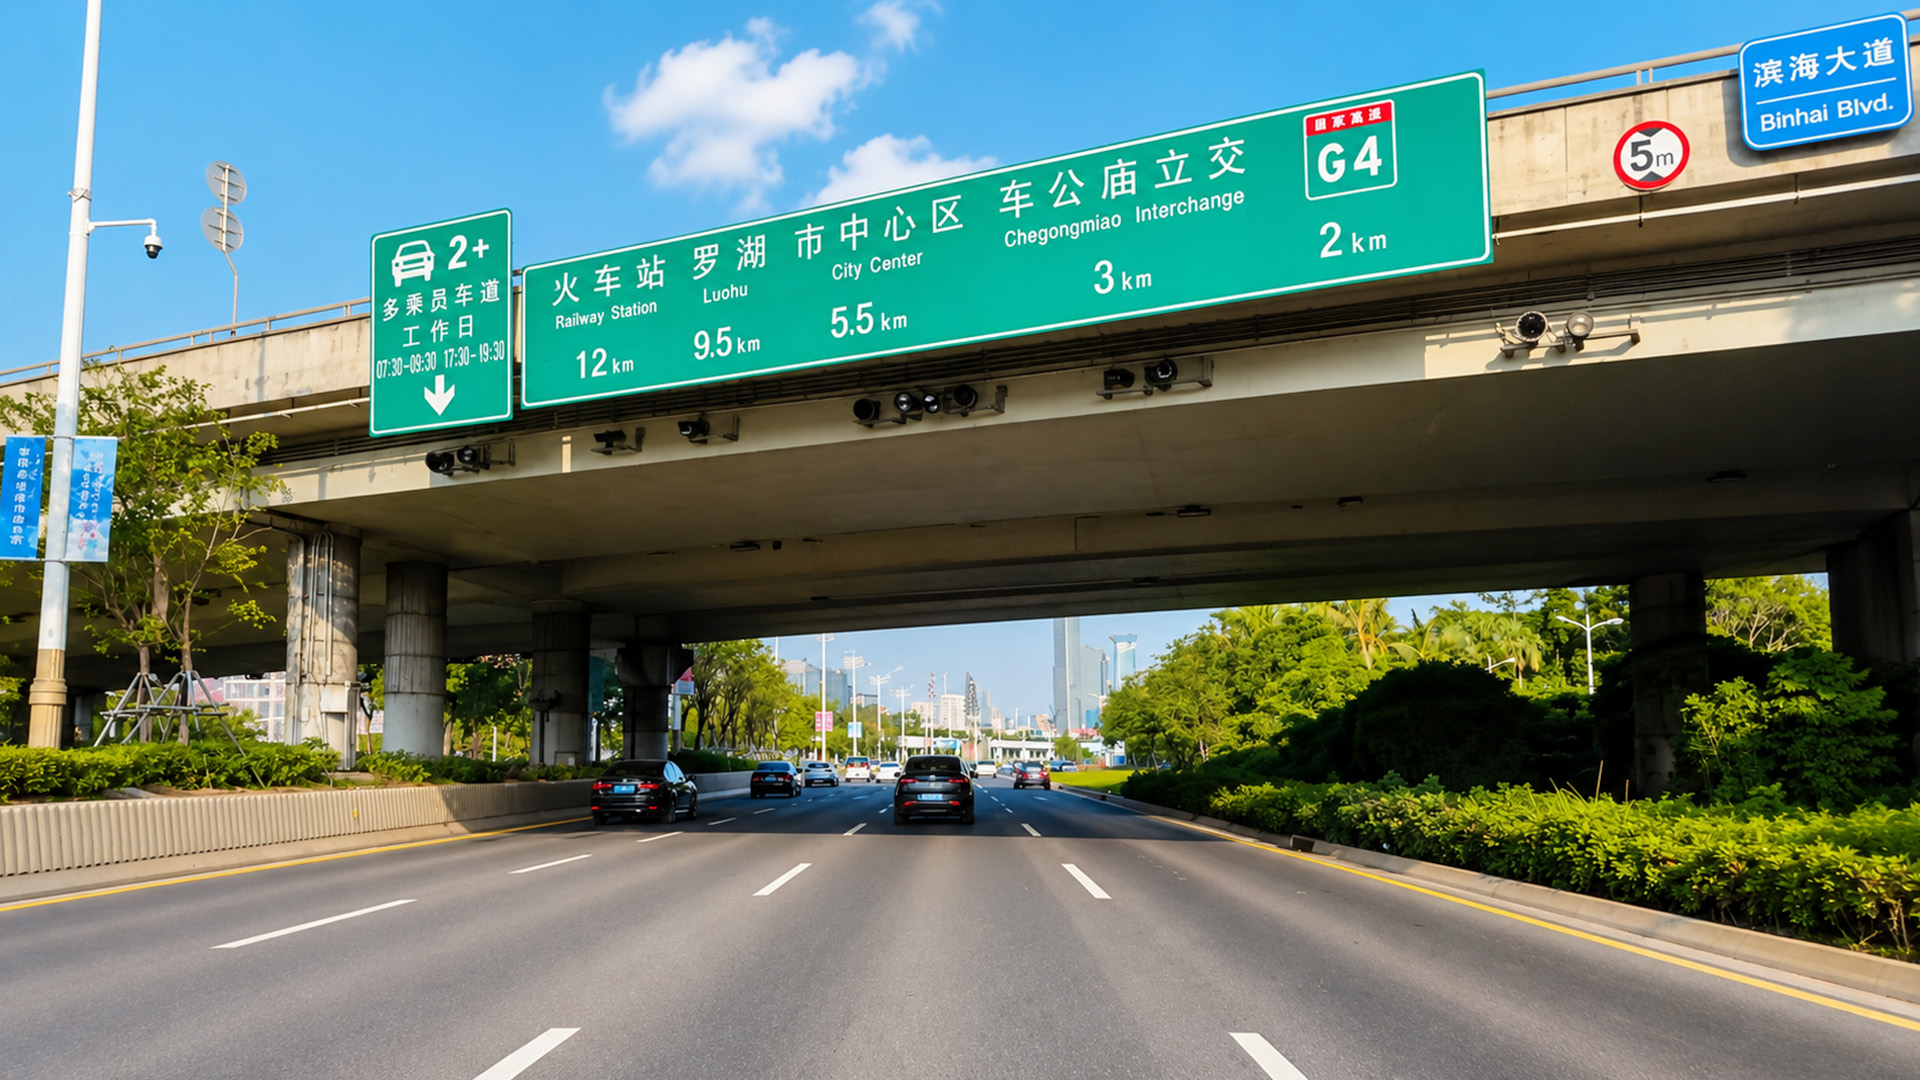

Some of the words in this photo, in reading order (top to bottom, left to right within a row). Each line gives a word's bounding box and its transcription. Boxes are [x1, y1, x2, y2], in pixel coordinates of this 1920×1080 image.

[1754, 37, 1894, 87] 滨海大道
[1761, 104, 1828, 131] Binhai
[1838, 93, 1893, 118] Blvd.
[1318, 136, 1382, 182] G4
[1000, 137, 1245, 218] 车公庙立交
[795, 195, 963, 259] 市中心区
[1005, 214, 1121, 247] Chegongmiao
[1136, 191, 1244, 222] Interchange
[448, 235, 489, 269] 2+
[694, 235, 765, 280] 罗湖
[1320, 222, 1342, 258] 2
[1352, 233, 1386, 253] km
[553, 255, 665, 306] 火车站
[833, 263, 862, 280] City
[871, 253, 922, 272] Center
[1094, 260, 1114, 294] 3
[1122, 272, 1151, 290] km
[383, 279, 499, 321] 多乘员车道
[704, 285, 747, 303] Luohu
[403, 315, 472, 347] 工作日
[556, 312, 604, 328] Railway
[612, 302, 656, 319] Station
[831, 302, 873, 338] 5.5
[882, 313, 906, 330] km
[694, 327, 732, 360] 9.5
[738, 338, 760, 353] km
[377, 352, 436, 378] 07:30-09:30
[577, 348, 607, 378] 12
[613, 358, 633, 373] km
